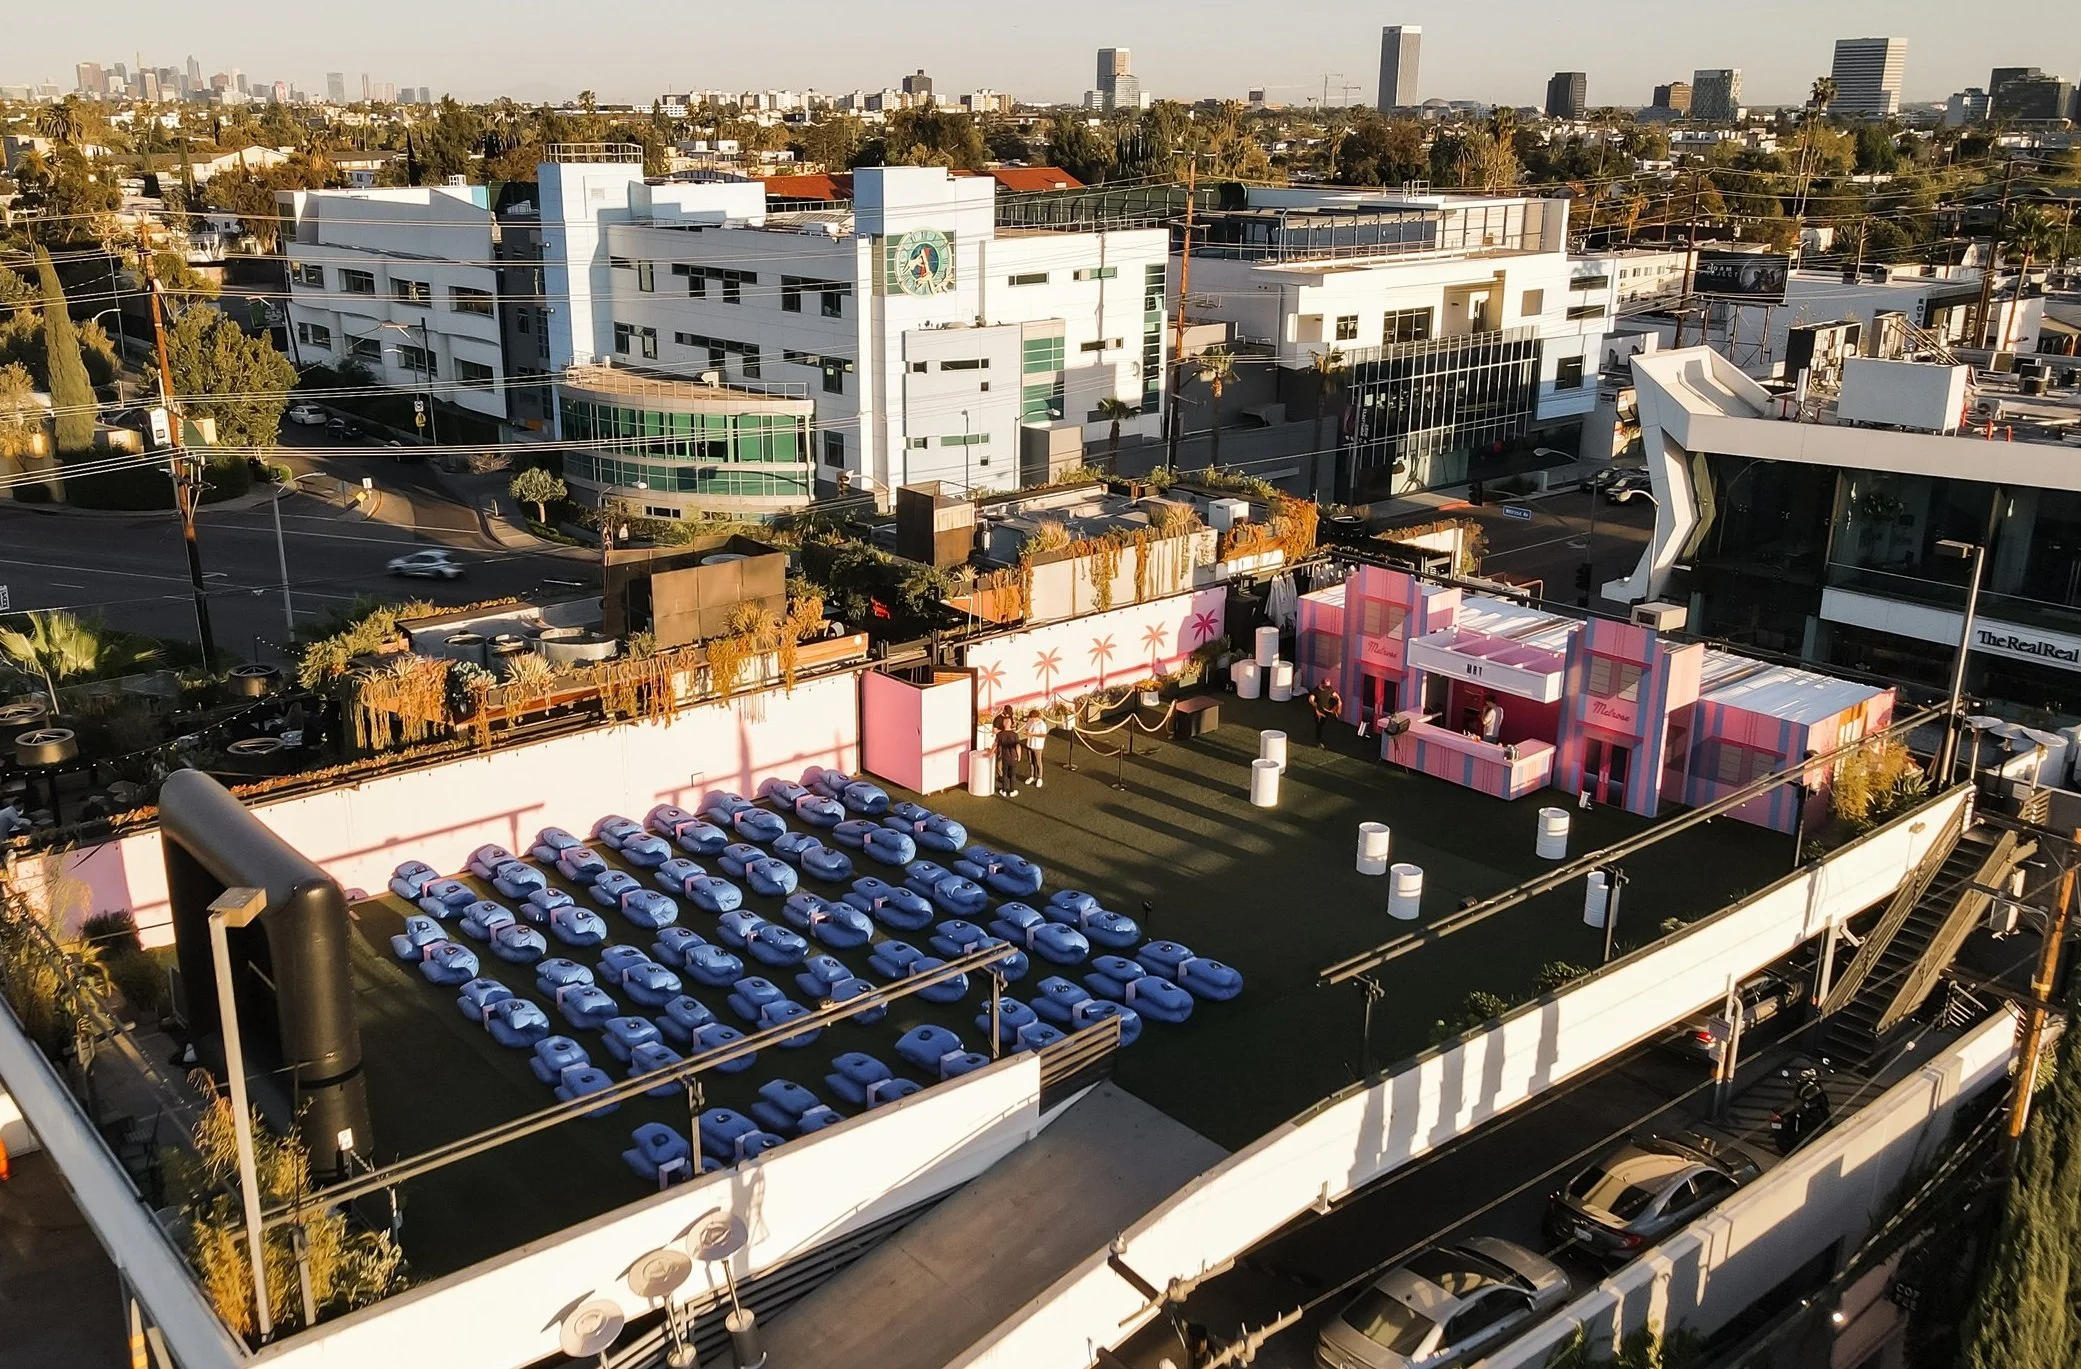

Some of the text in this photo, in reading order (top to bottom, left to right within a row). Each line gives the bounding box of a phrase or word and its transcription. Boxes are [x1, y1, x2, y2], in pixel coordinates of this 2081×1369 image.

[1367, 641, 1398, 658] Melrose
[1977, 630, 2079, 663] TheRealReal
[1592, 701, 1632, 722] Melrose
